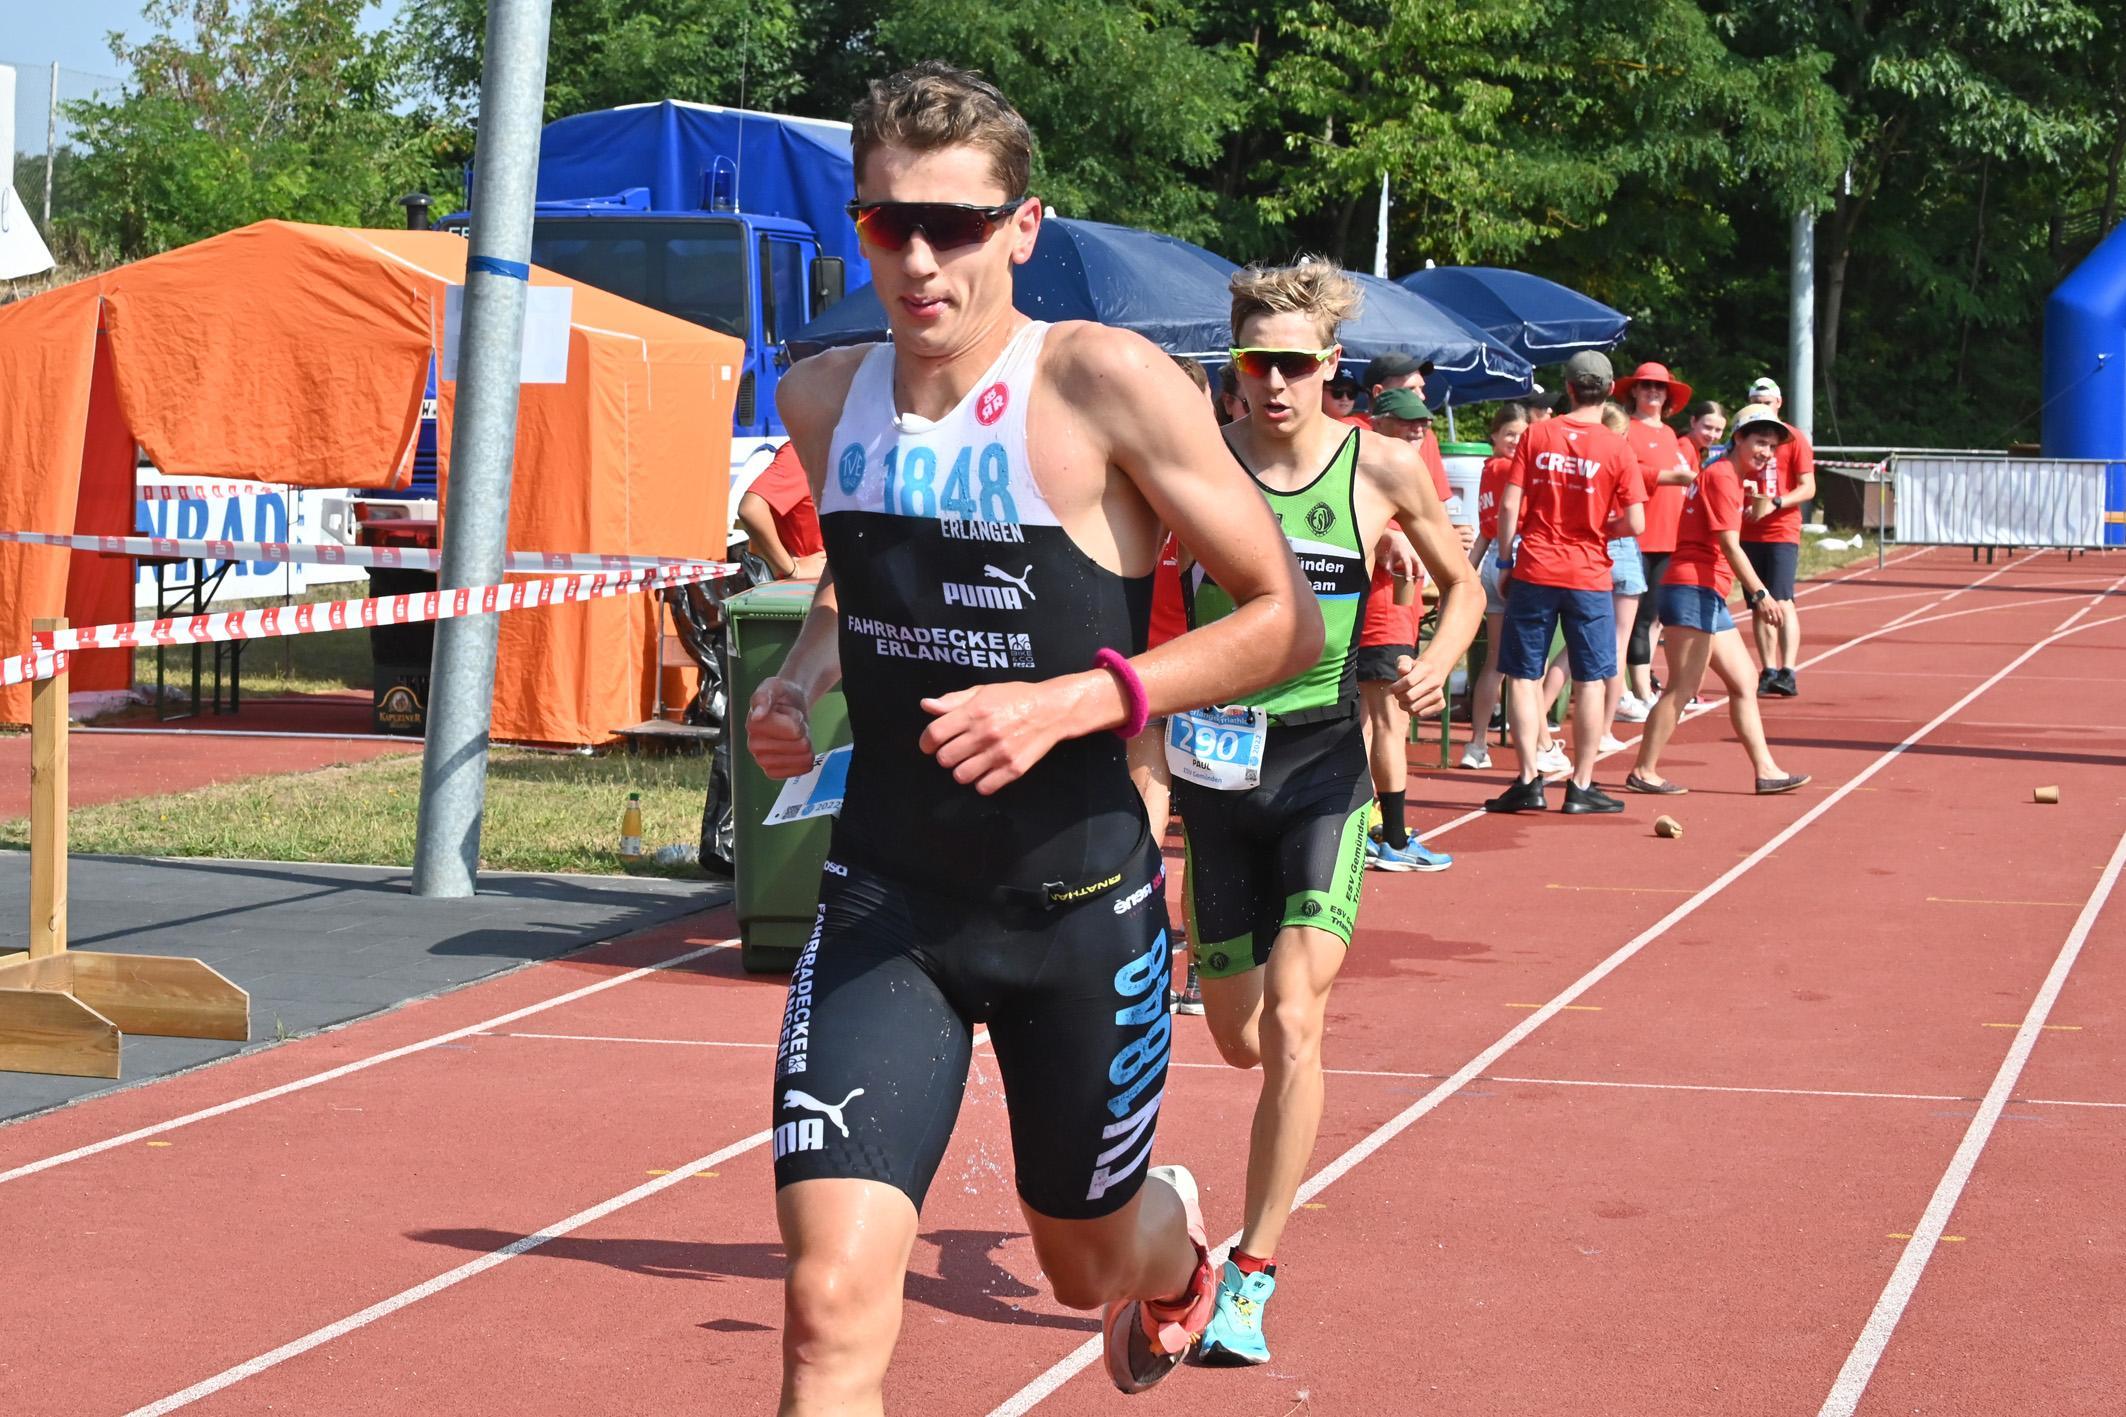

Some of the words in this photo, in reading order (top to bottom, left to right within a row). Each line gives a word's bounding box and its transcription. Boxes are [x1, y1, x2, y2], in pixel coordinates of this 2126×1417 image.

[1535, 452, 1601, 480] CREW
[883, 442, 1020, 525] 1848
[940, 517, 1025, 543] ERLANGEN
[942, 582, 1023, 610] PUMA
[1308, 581, 1336, 592] am
[848, 615, 1006, 650] FAHRRADECKE
[876, 639, 1009, 669] ERLANGEN
[1180, 720, 1239, 761] 290
[1192, 758, 1212, 771] PAUL
[815, 800, 841, 812] 2022
[1350, 811, 1366, 874] Gemünden
[1345, 875, 1356, 902] ESV
[788, 903, 826, 1058] FAHRRADECKE
[1107, 928, 1171, 1118] 1848
